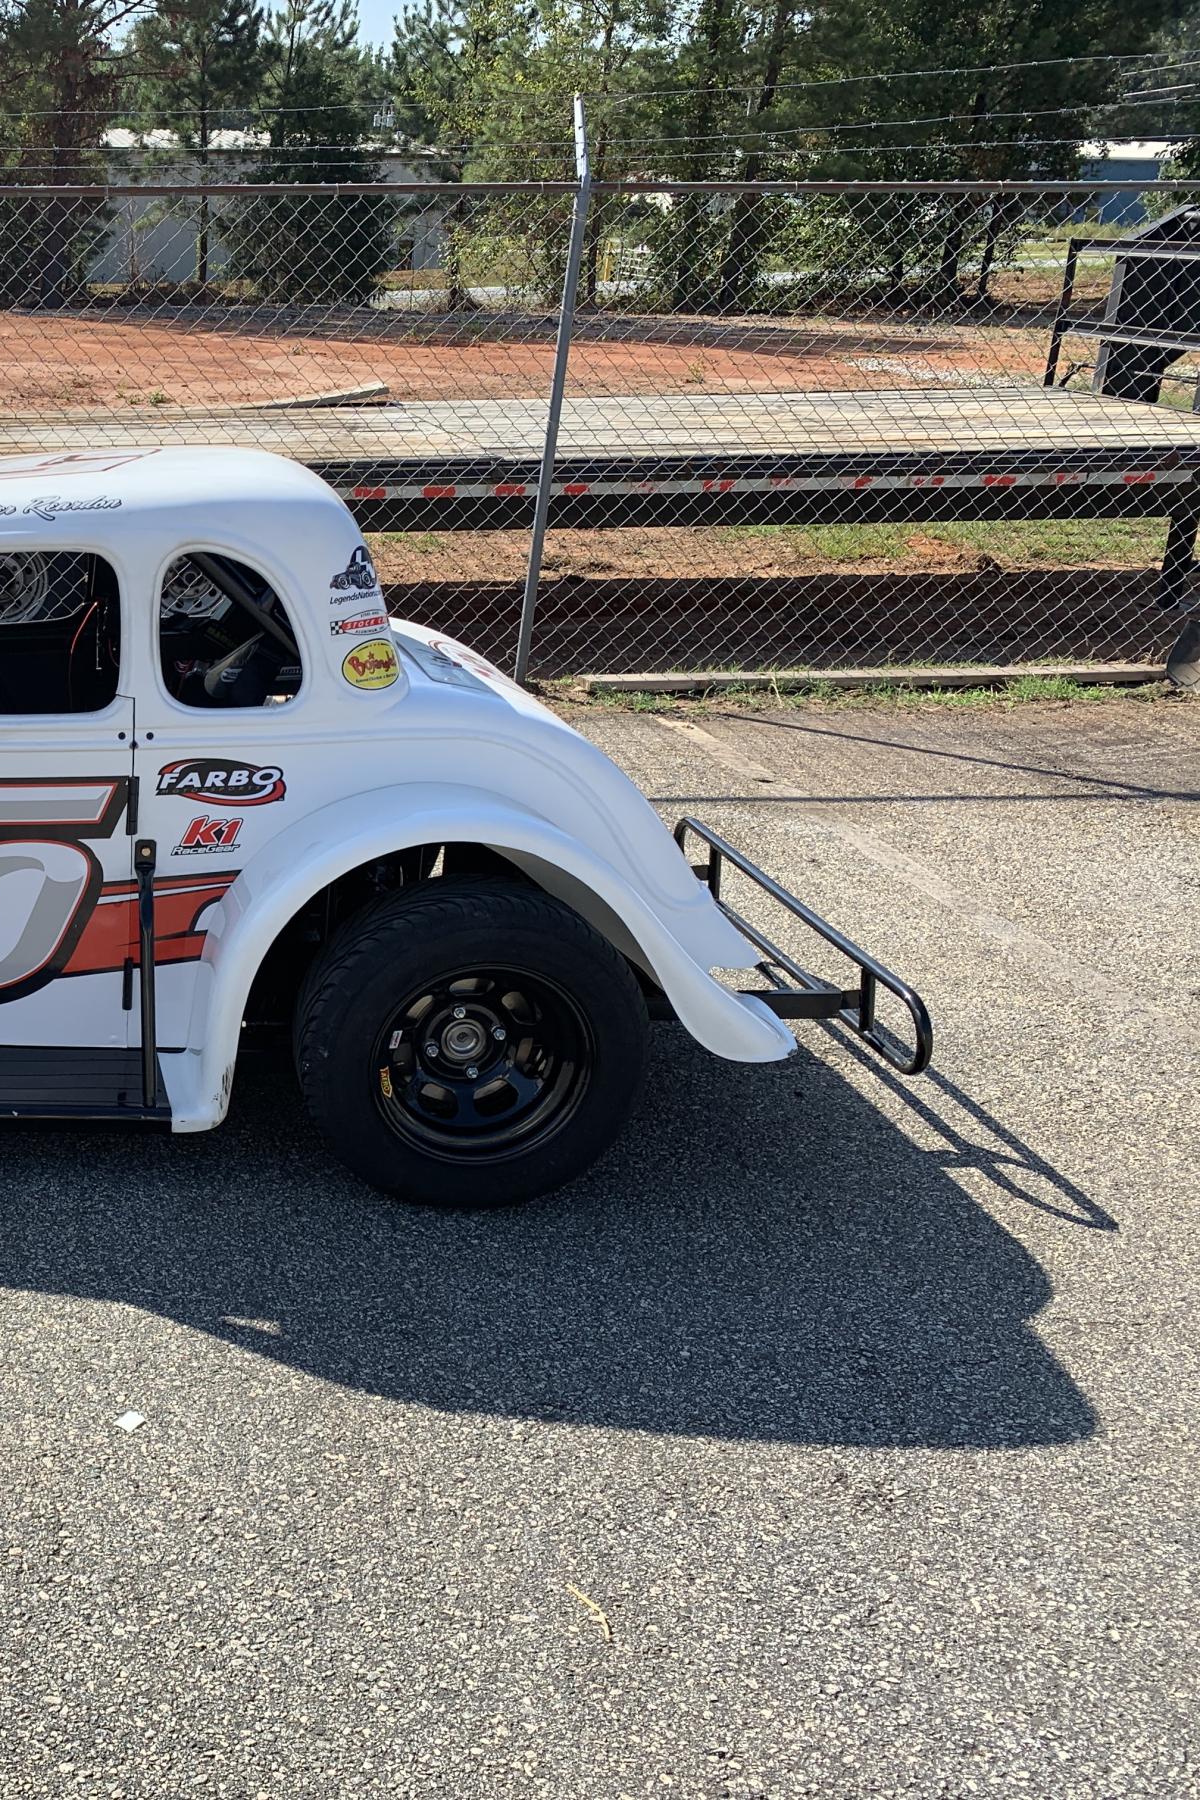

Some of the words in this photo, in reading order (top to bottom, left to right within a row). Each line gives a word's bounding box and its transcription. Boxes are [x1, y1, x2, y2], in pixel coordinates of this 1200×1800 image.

[23, 494, 123, 521] Reardon
[158, 768, 281, 790] FARBO
[180, 816, 243, 846] K1
